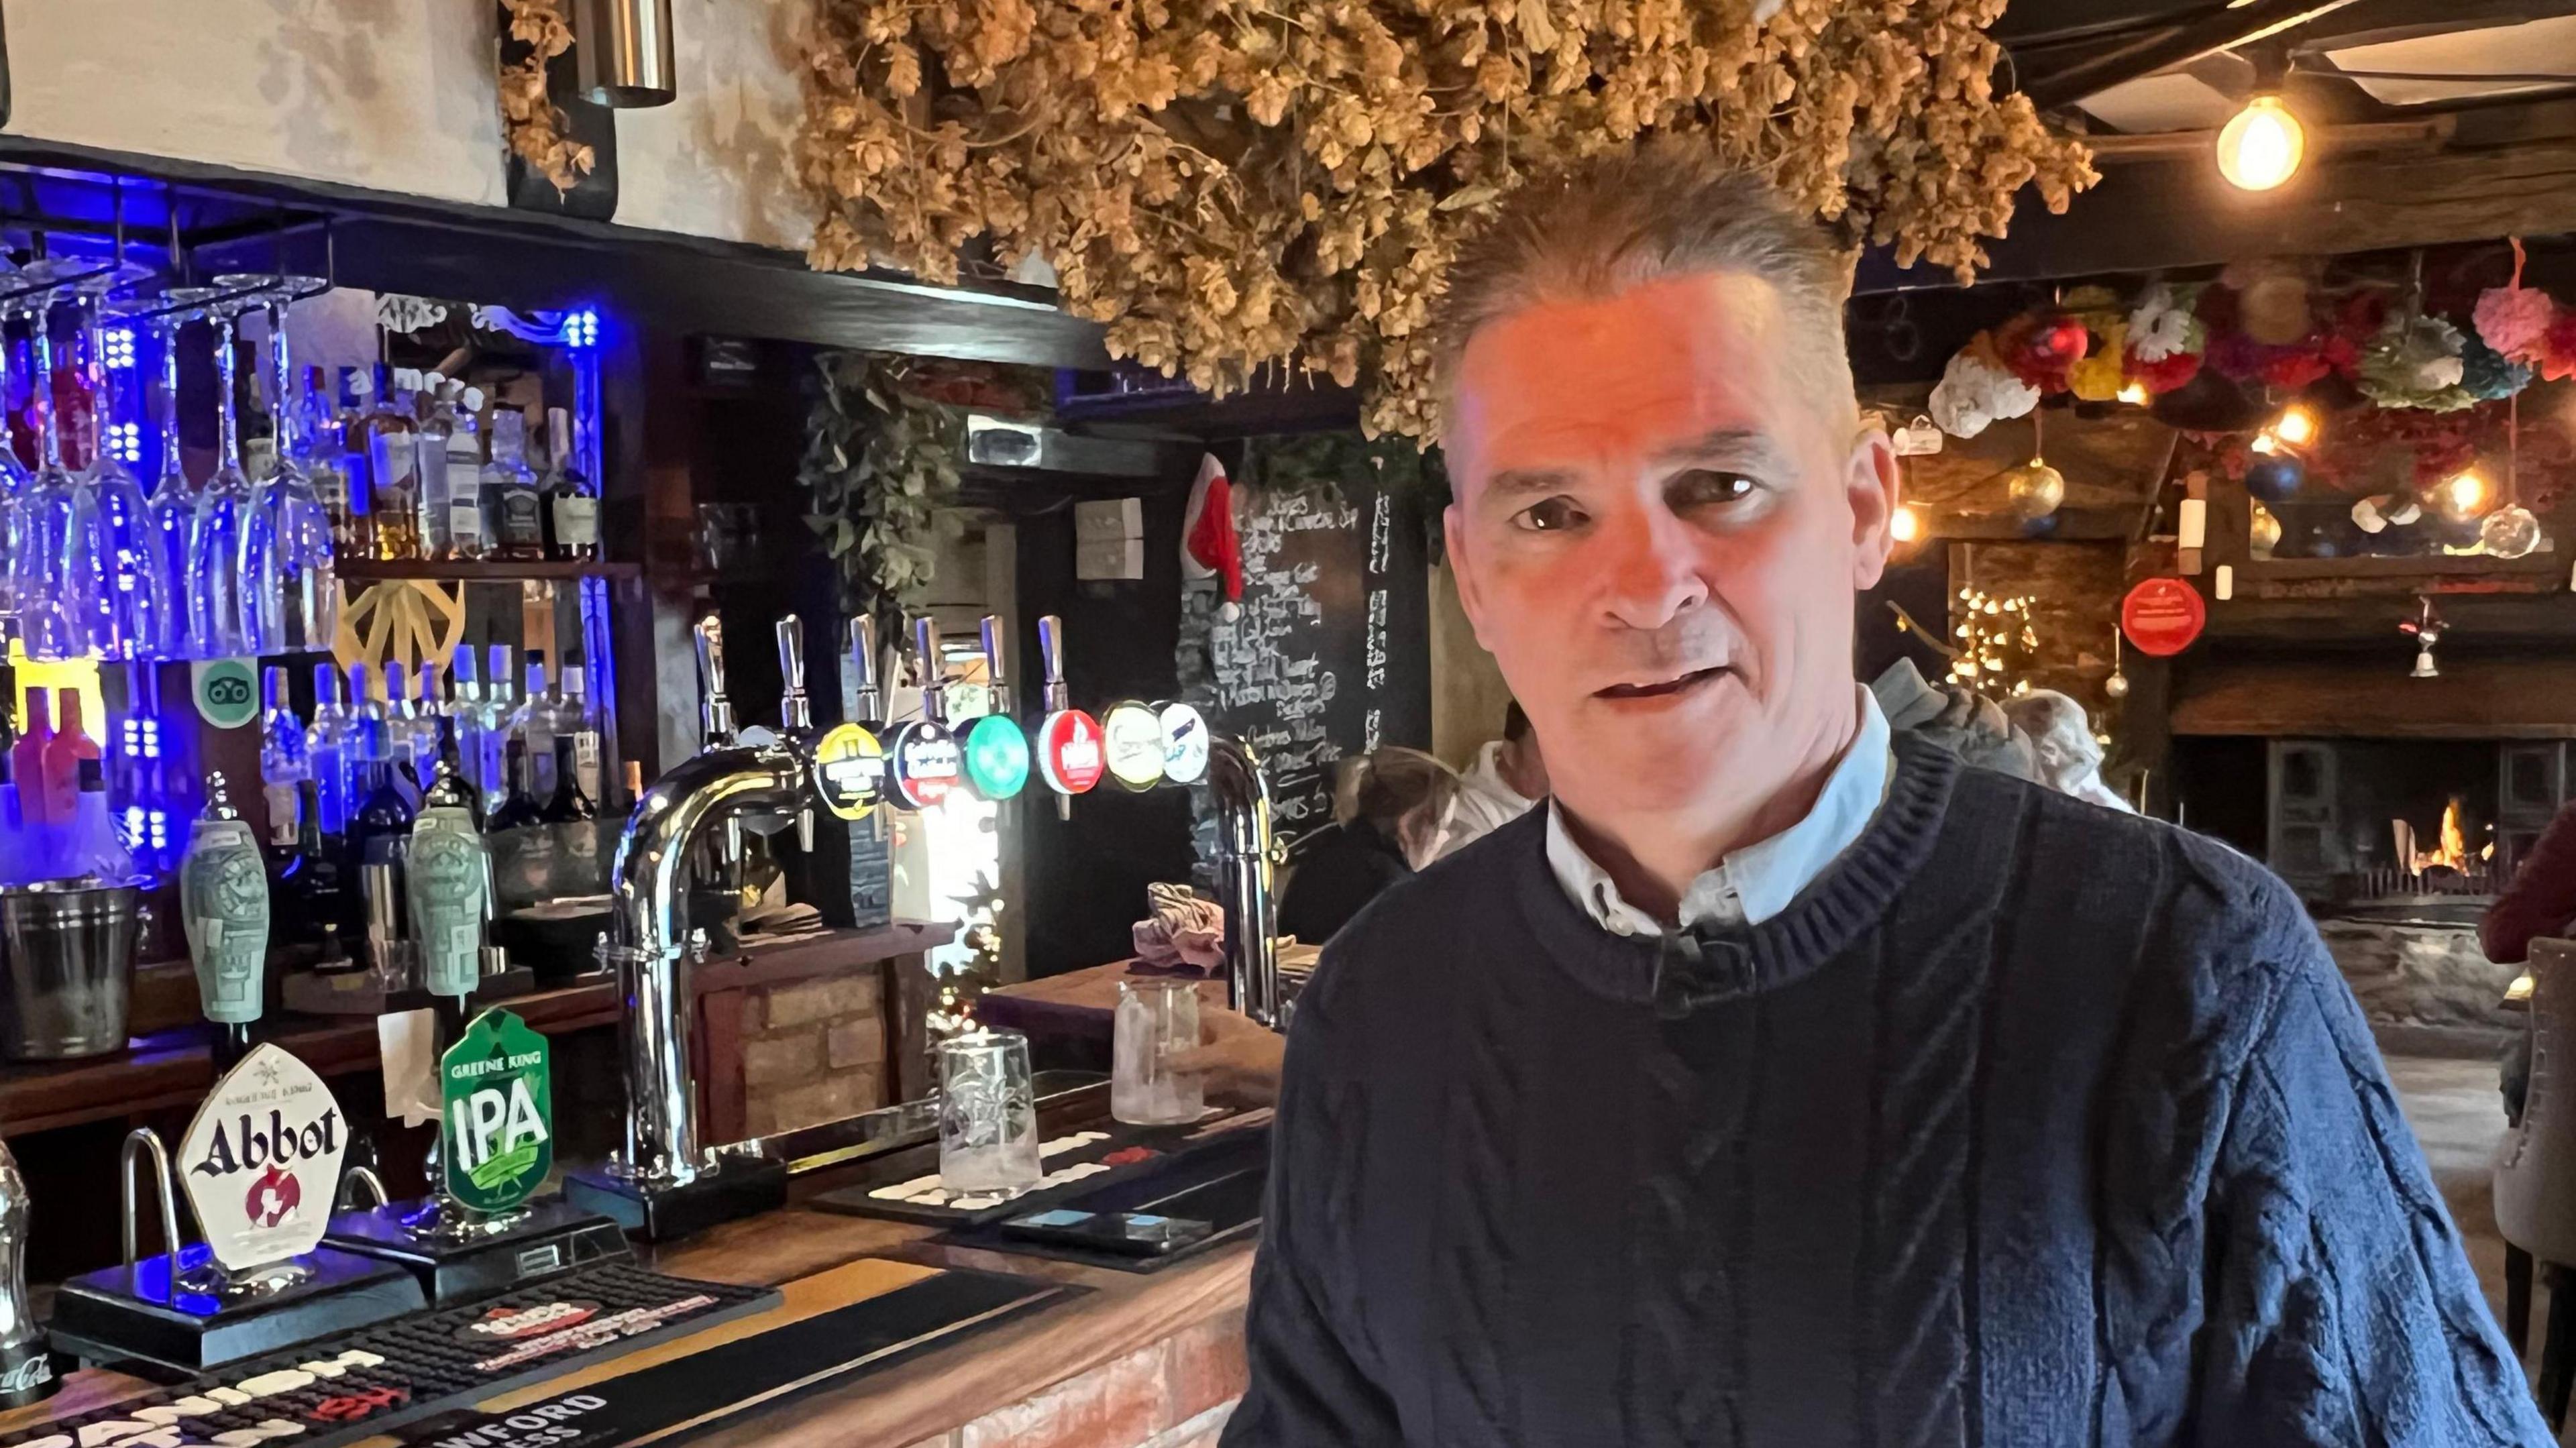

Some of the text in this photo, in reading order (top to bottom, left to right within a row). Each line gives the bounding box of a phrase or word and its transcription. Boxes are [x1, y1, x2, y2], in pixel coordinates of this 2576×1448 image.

[451, 1050, 541, 1078] GREENE KING
[191, 1107, 337, 1178] Abbot
[453, 1077, 549, 1172] IPA
